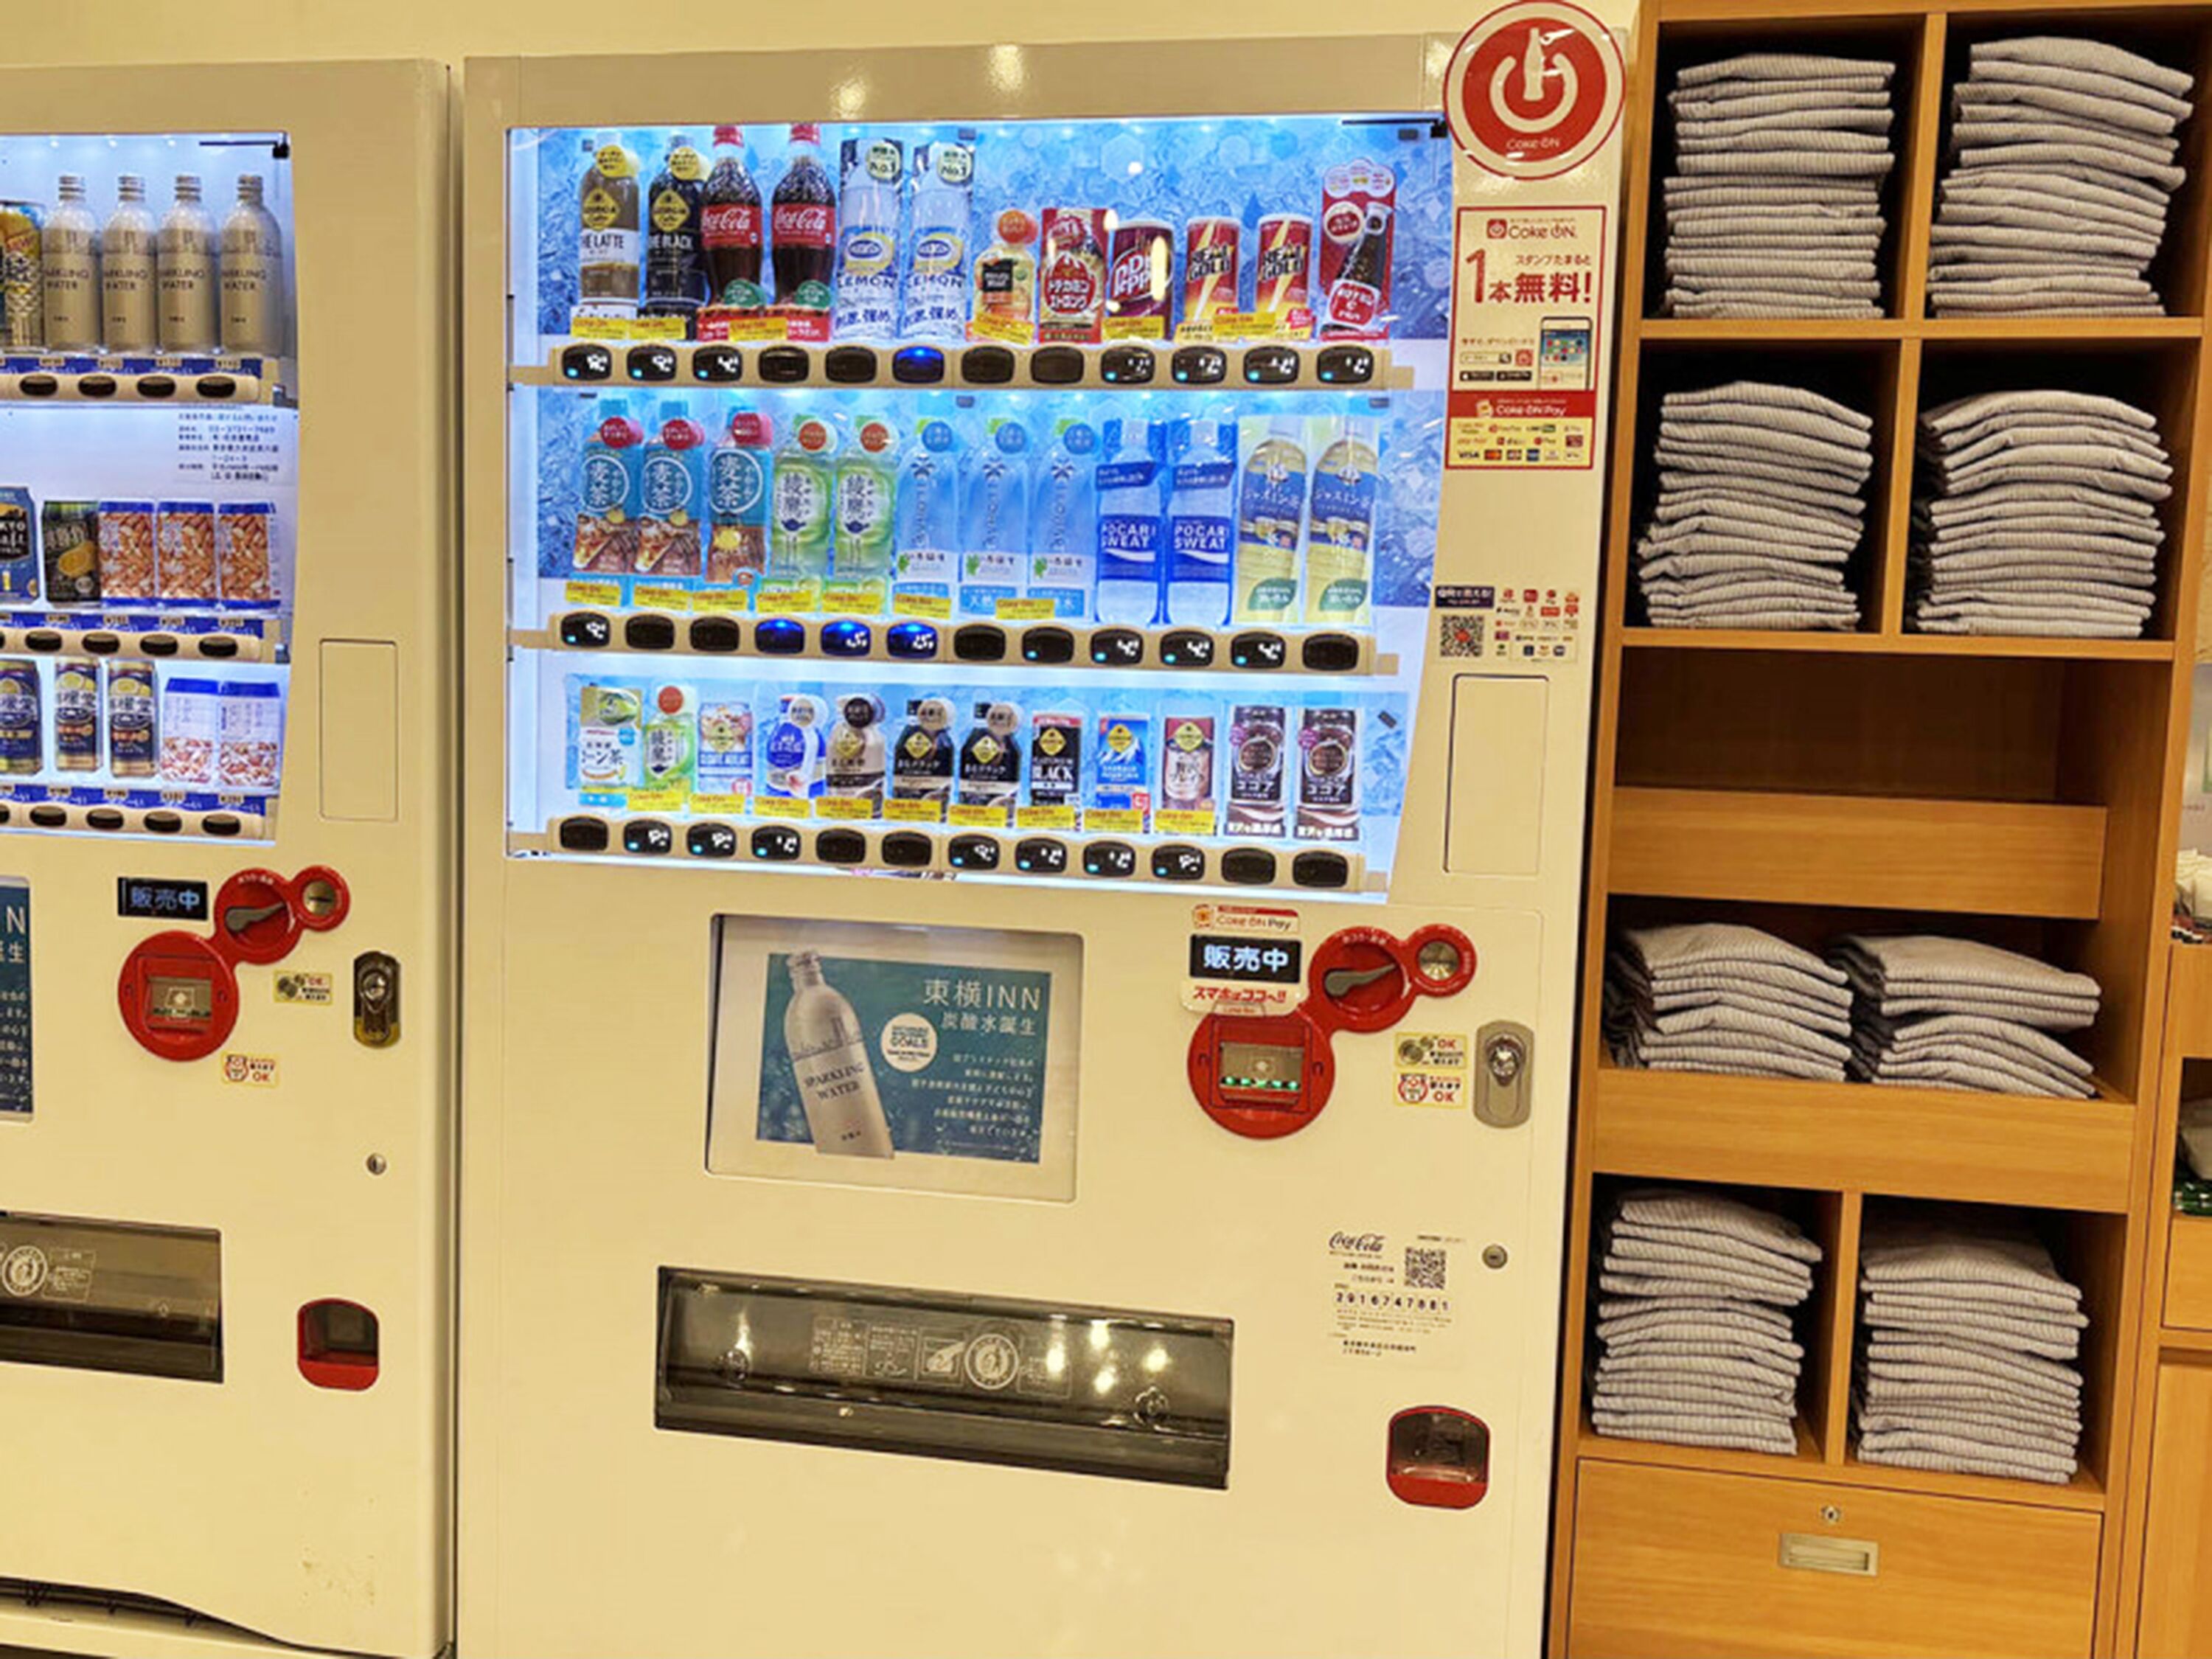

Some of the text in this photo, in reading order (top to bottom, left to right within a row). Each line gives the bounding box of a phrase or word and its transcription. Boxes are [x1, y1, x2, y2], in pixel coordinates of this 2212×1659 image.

[1509, 224, 1548, 239] Coke
[594, 234, 625, 249] LATTE
[46, 279, 77, 290] WATER
[161, 279, 195, 290] WATER
[223, 279, 256, 291] WATER
[836, 274, 895, 290] LEMON
[905, 274, 964, 290] LEMON
[1102, 524, 1156, 537] POCARI
[1174, 524, 1229, 538] POCARI
[1101, 537, 1150, 549] SWEAT
[1174, 538, 1226, 550] SWEAT
[1032, 765, 1074, 782] BLACK
[1237, 779, 1275, 793] ココア
[1307, 782, 1347, 796] ココア
[129, 887, 201, 911] 販売中
[1203, 944, 1289, 974] 販売中
[923, 978, 1041, 1012] 東横INN
[1437, 1038, 1456, 1049] OK
[252, 1071, 271, 1083] OK
[804, 1061, 865, 1088] SPARKLING
[816, 1080, 861, 1101] WATER
[1433, 1091, 1455, 1102] OK
[1329, 1231, 1385, 1252] Coca-Cola
